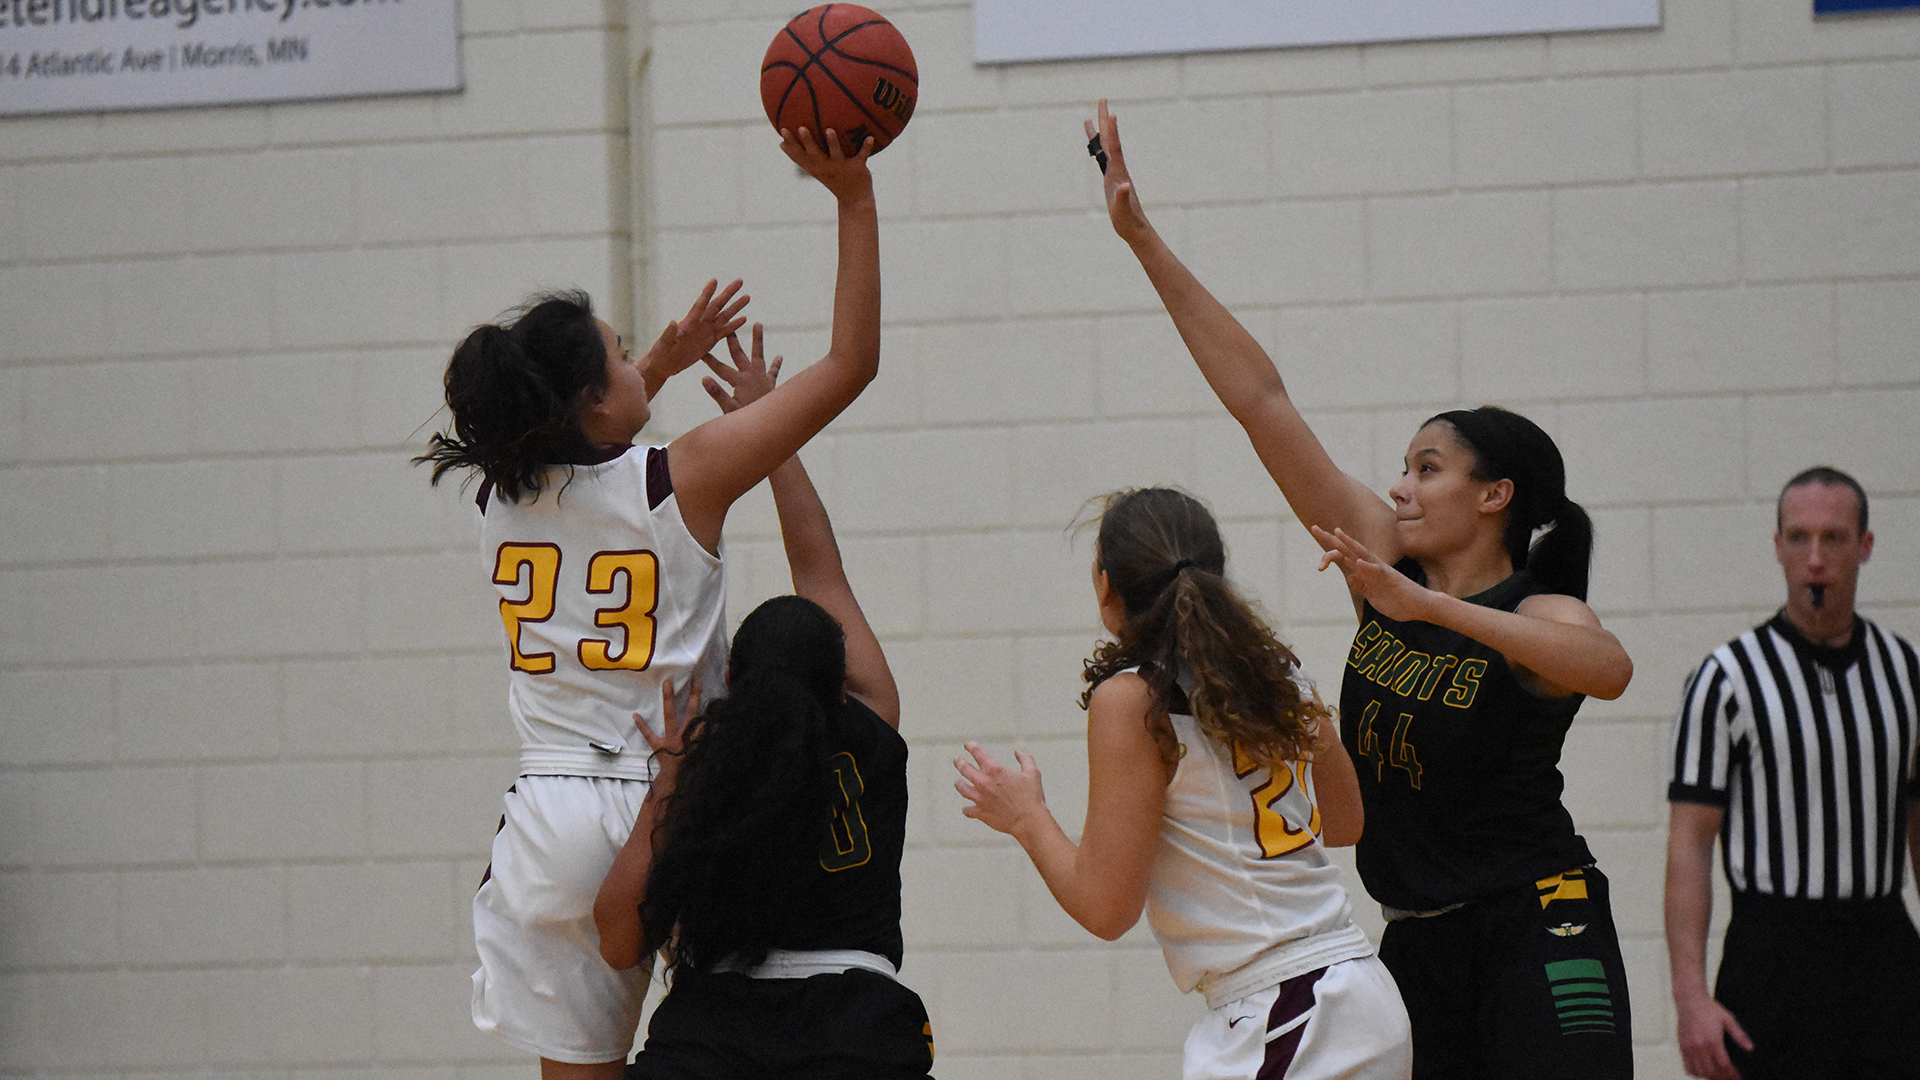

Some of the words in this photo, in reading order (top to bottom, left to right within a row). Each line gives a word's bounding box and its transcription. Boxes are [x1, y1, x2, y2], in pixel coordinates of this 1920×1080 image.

[0, 0, 401, 29] tendreagey.
[25, 52, 114, 79] Atlantic
[120, 45, 163, 73] Ave
[267, 37, 309, 63] MN
[492, 541, 660, 675] 23
[1347, 620, 1488, 709] SAINTS
[1358, 699, 1423, 790] 44
[1231, 738, 1321, 860] 2
